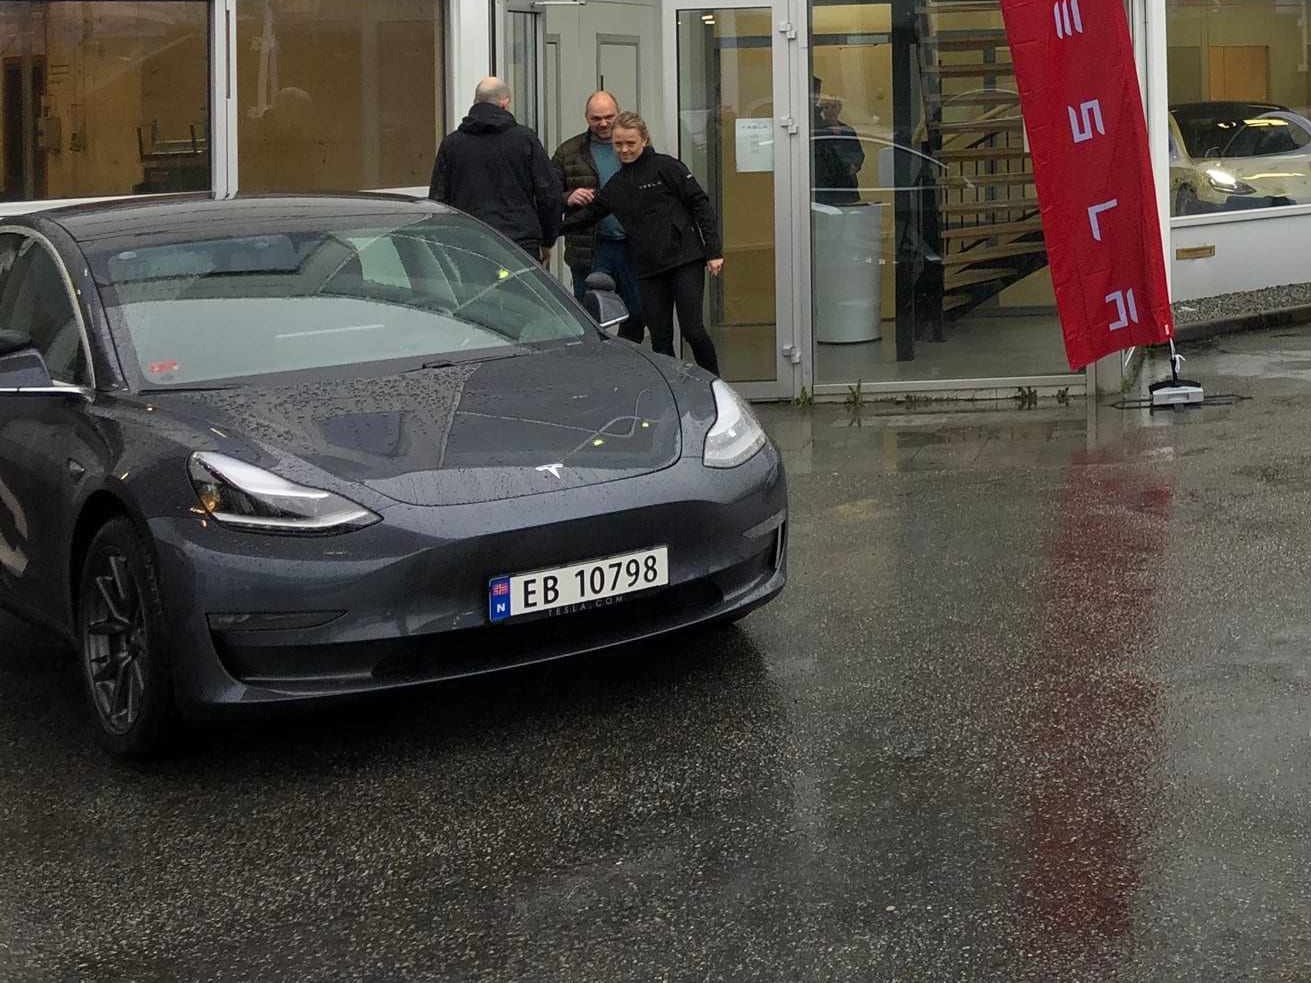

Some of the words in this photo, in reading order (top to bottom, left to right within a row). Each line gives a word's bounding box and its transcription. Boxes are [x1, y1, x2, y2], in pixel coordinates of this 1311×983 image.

[496, 602, 506, 613] N
[523, 575, 560, 609] EB
[574, 555, 658, 598] 10798
